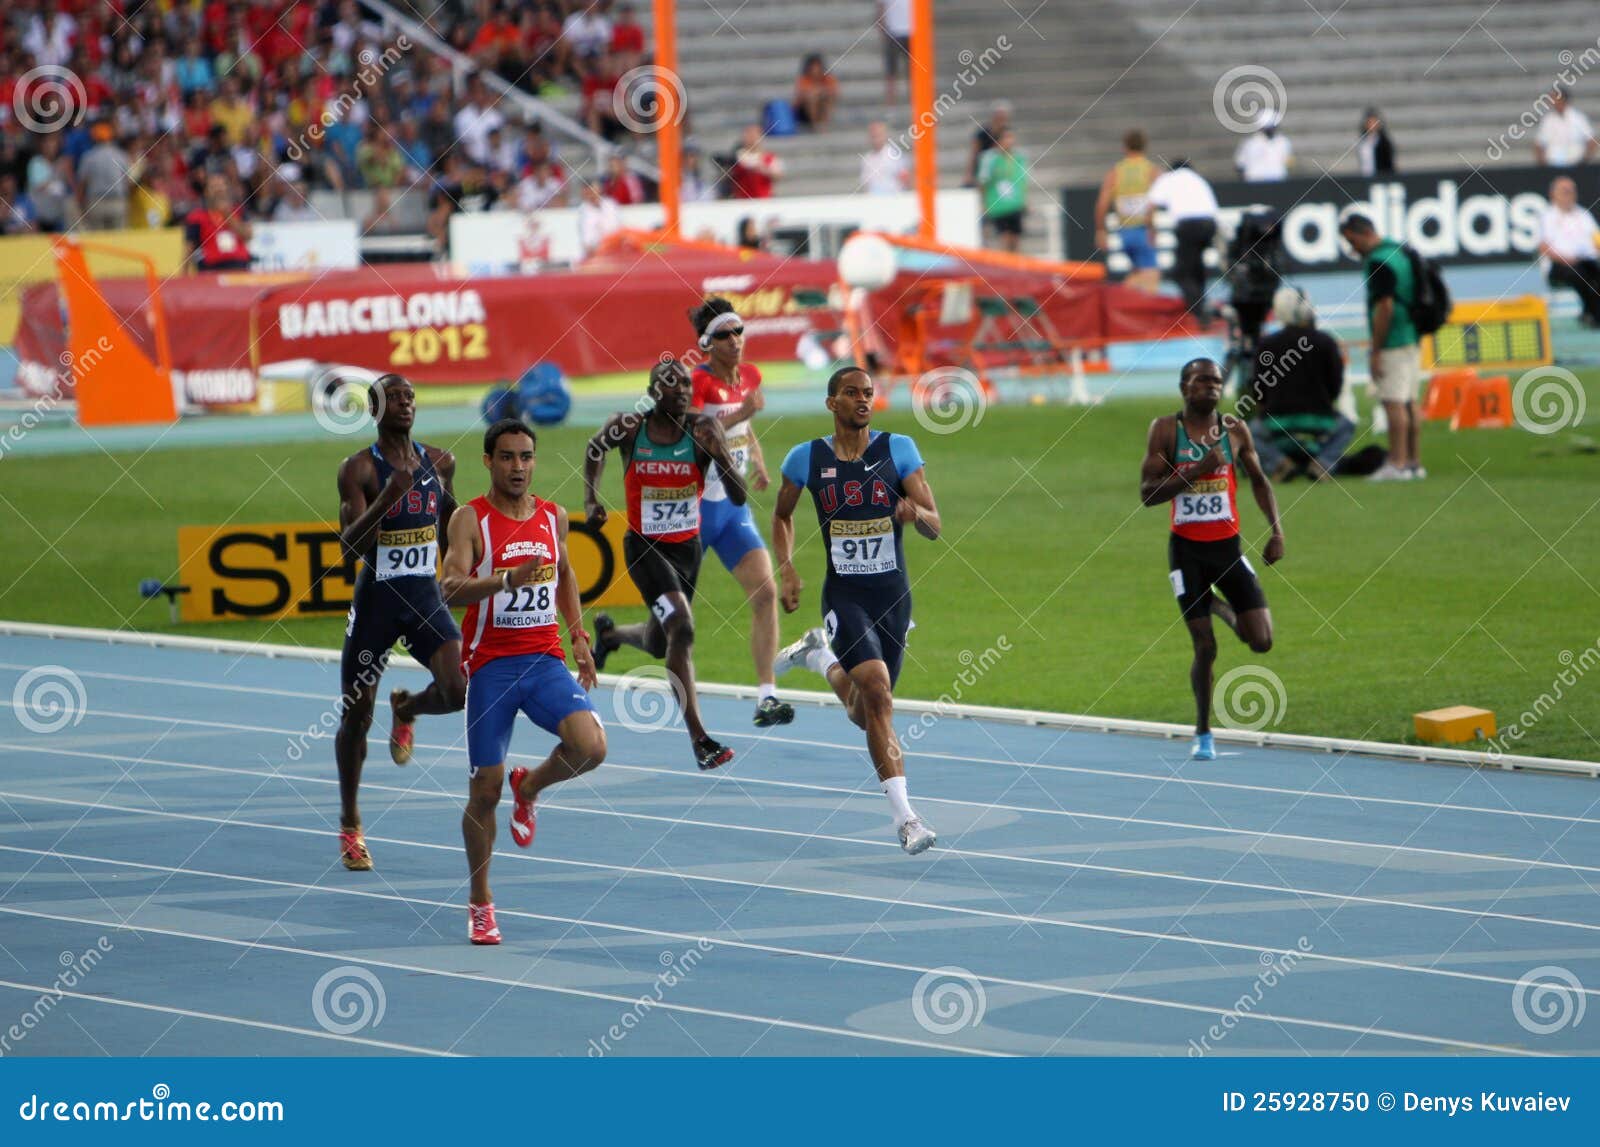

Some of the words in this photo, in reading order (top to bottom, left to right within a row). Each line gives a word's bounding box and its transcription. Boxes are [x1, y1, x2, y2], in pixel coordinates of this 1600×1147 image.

[1282, 180, 1549, 263] adidas
[279, 289, 486, 339] BARCELONA
[388, 324, 490, 365] 2012
[636, 462, 691, 475] KENYA
[644, 484, 696, 499] SEIKO
[820, 480, 891, 513] USA
[652, 502, 690, 521] 574
[1182, 496, 1223, 515] 568
[380, 528, 435, 545] SEIKO
[831, 519, 891, 536] SEIKO
[501, 548, 552, 561] DOMINICANA
[506, 541, 547, 552] REPUBLICA
[842, 537, 883, 560] 917
[388, 547, 428, 569] 901
[834, 563, 878, 573] BARCELONA
[881, 560, 895, 571] 2012
[504, 586, 550, 612] 228
[496, 616, 541, 626] BARCELONA
